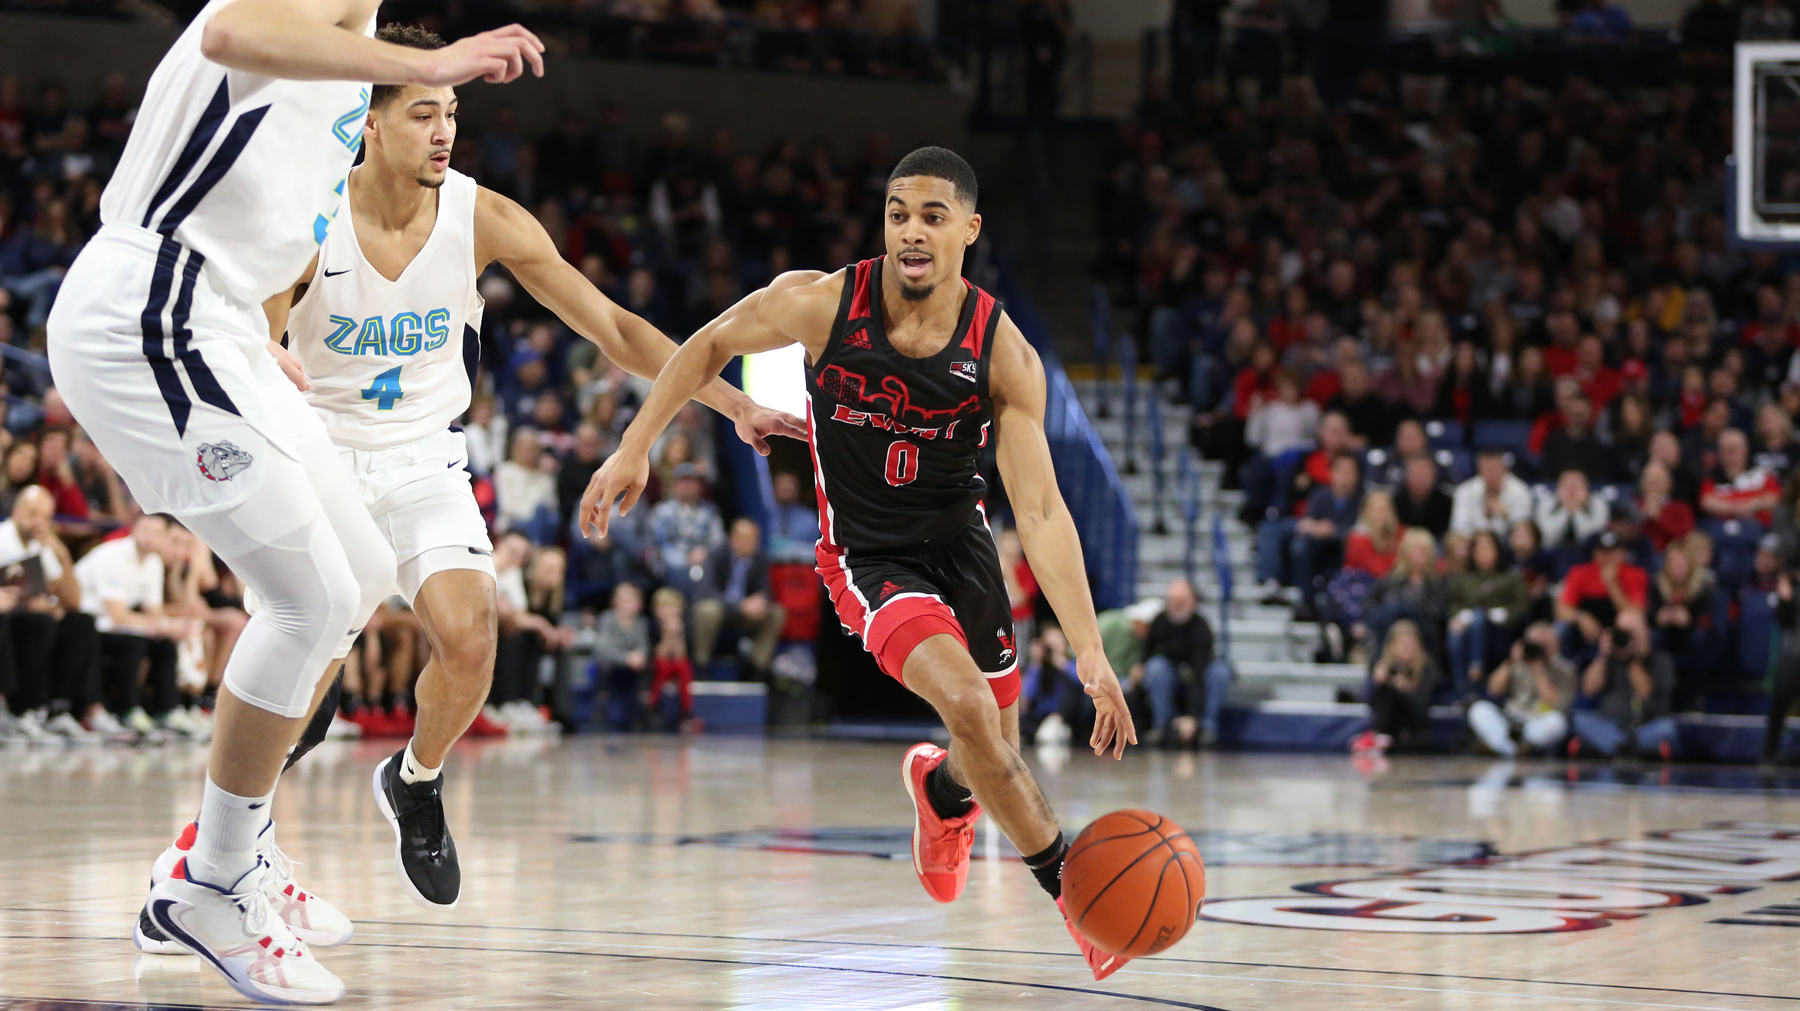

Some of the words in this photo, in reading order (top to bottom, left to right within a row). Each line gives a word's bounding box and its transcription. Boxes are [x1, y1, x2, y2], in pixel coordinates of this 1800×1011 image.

[323, 307, 450, 356] ZAGS
[843, 338, 873, 350] adidas
[360, 364, 404, 411] 4
[884, 439, 919, 487] 0
